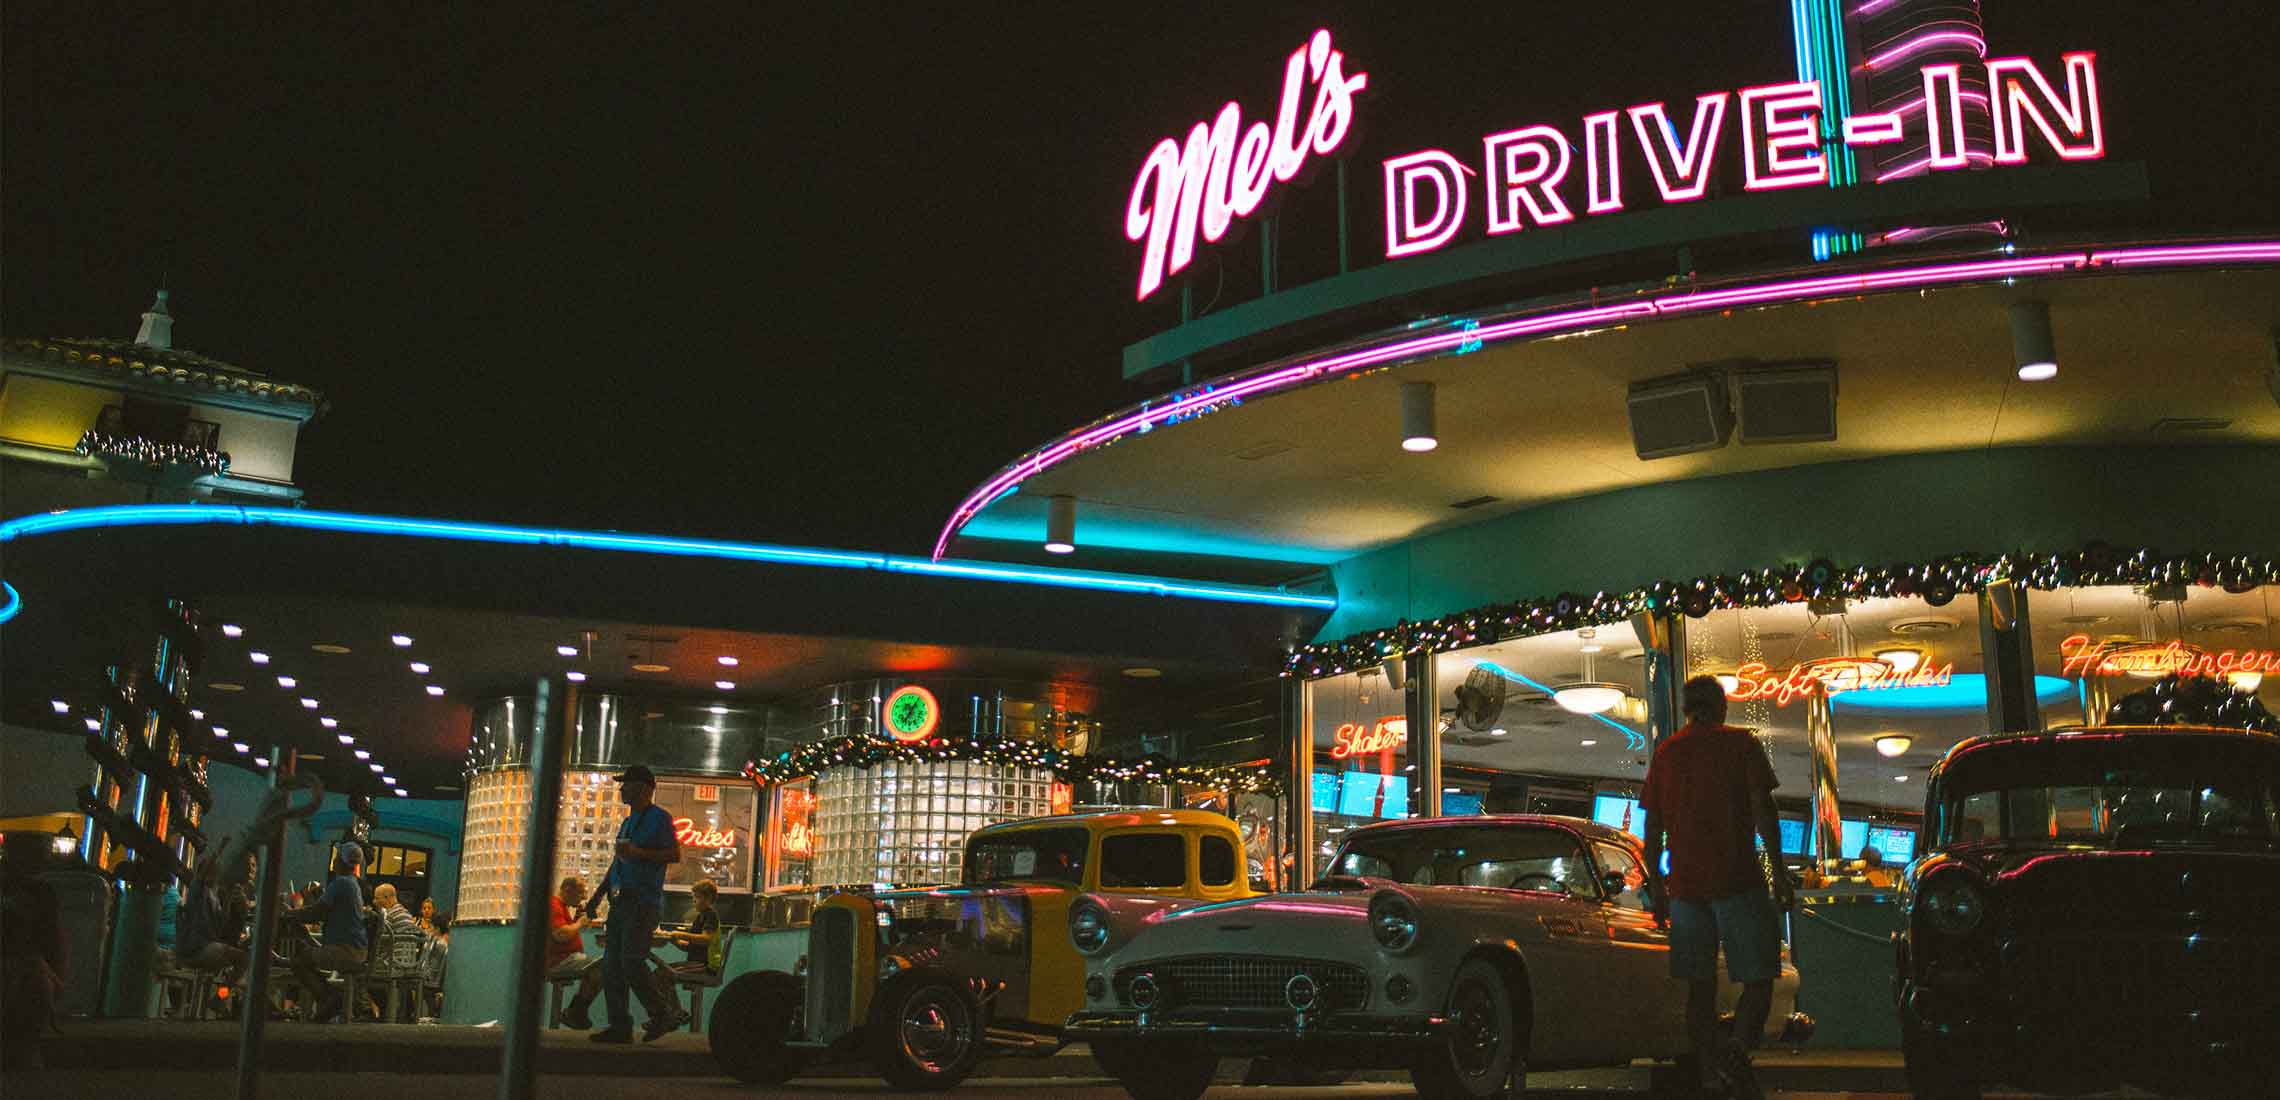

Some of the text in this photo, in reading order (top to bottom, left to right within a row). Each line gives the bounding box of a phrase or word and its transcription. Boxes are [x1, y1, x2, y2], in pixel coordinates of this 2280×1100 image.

[1124, 28, 2104, 303] Mel's DRIVE-IN
[1728, 655, 1953, 706] Soft Drinks
[1331, 721, 1401, 759] Shakes
[672, 816, 736, 849] Fries
